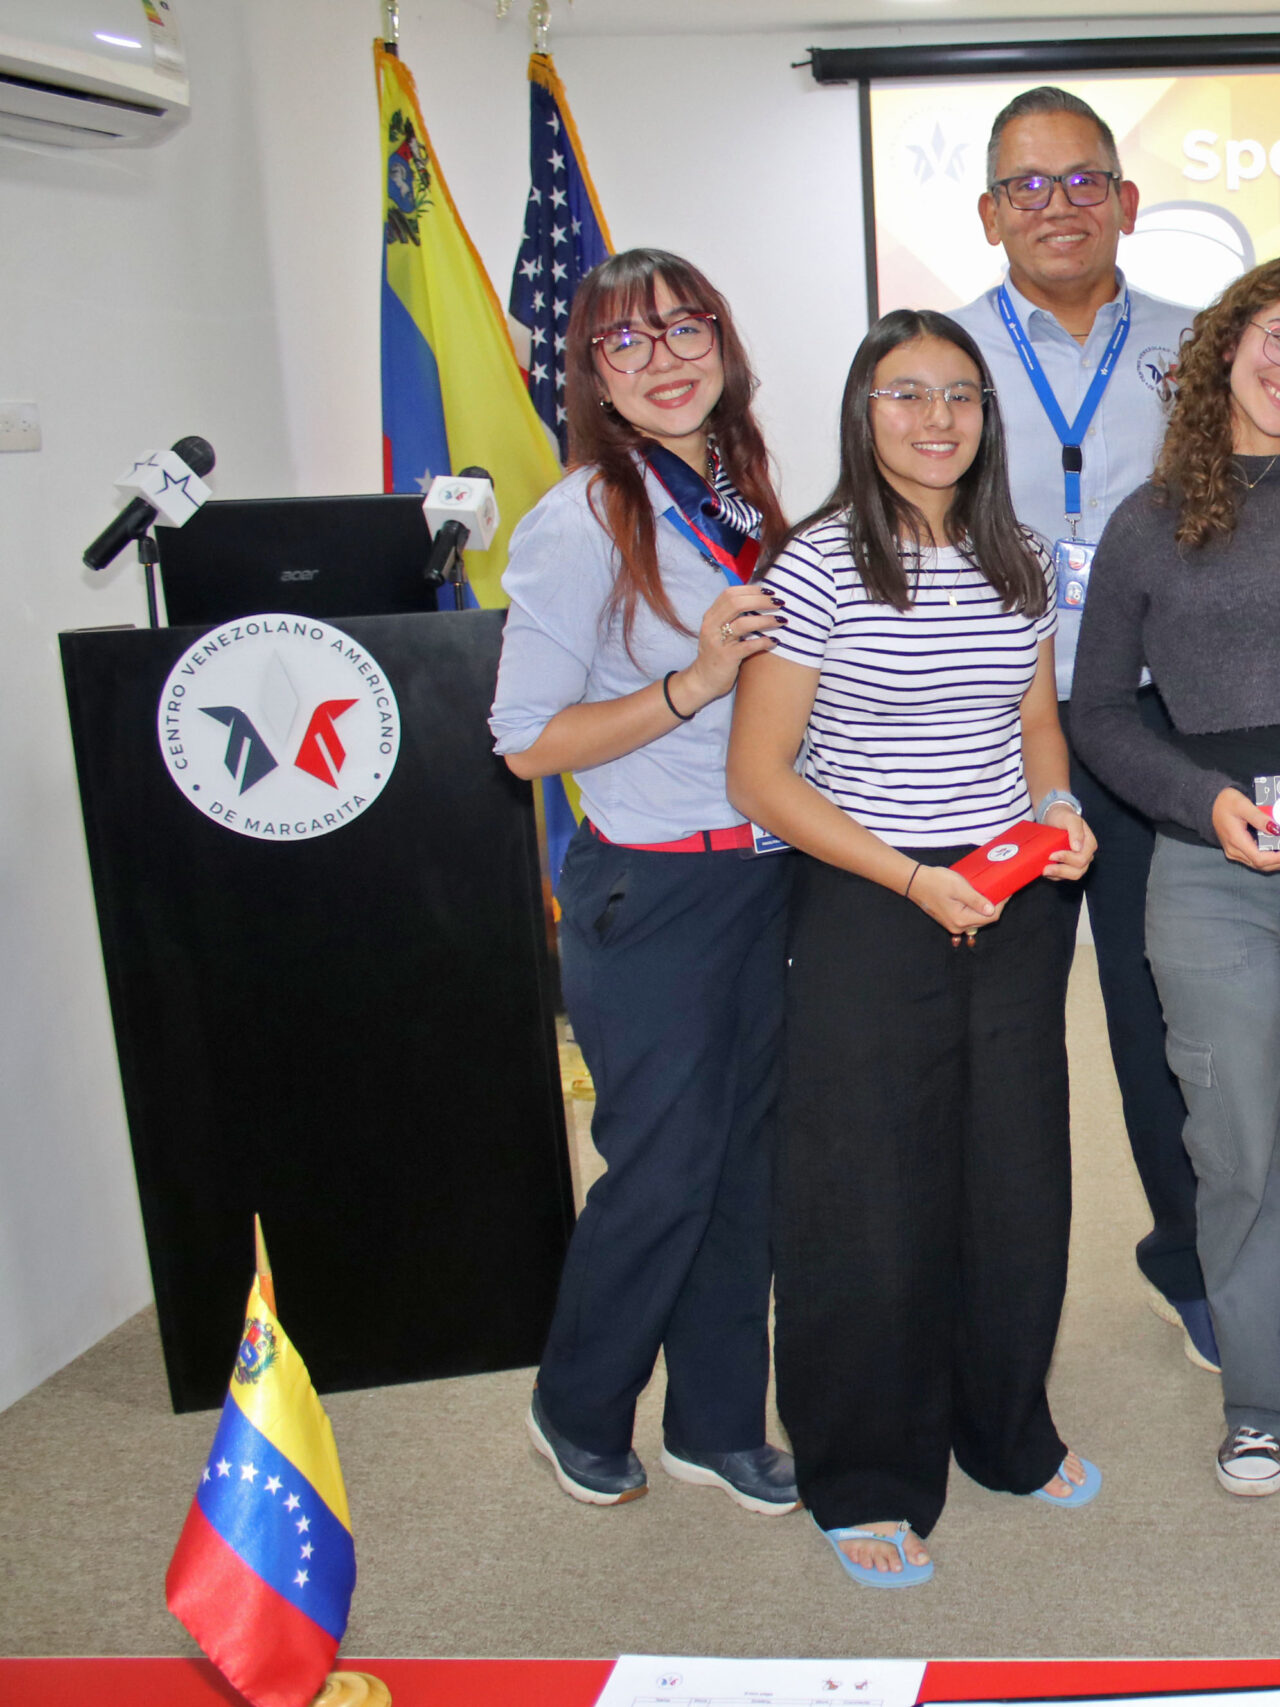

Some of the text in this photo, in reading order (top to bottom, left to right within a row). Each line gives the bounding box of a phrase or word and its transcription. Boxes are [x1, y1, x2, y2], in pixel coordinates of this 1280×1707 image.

[280, 569, 320, 582] acer
[166, 621, 393, 770] CENTRO VENEZOLANO AMERICANO
[209, 795, 367, 836] DE MARGARITA
